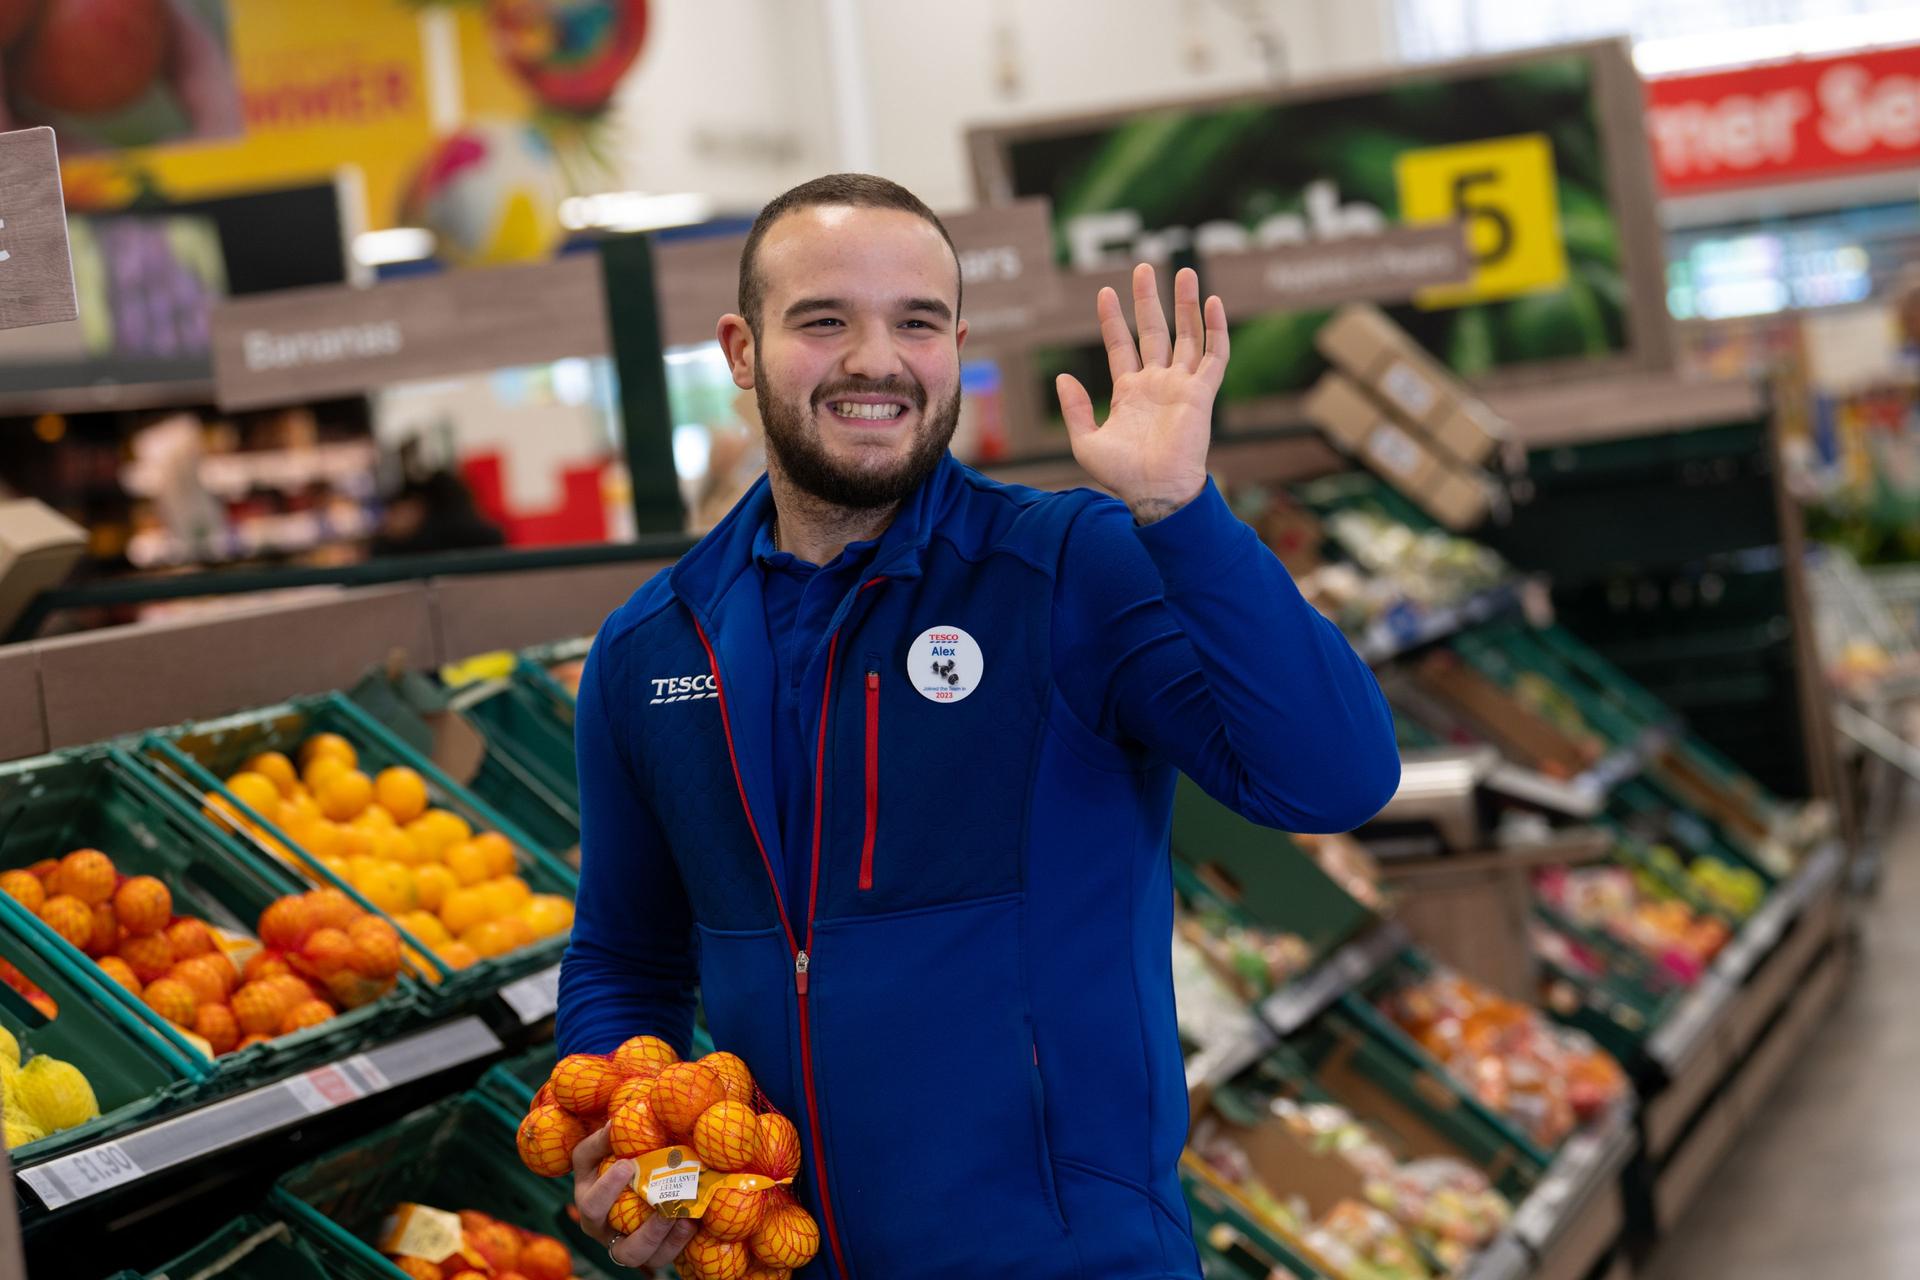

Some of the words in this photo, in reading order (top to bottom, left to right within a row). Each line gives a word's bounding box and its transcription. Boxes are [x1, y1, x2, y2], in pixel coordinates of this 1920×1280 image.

[1454, 169, 1514, 266] 5
[245, 322, 402, 370] Bananas
[931, 646, 956, 656] Alex
[73, 1146, 132, 1183] £1.90
